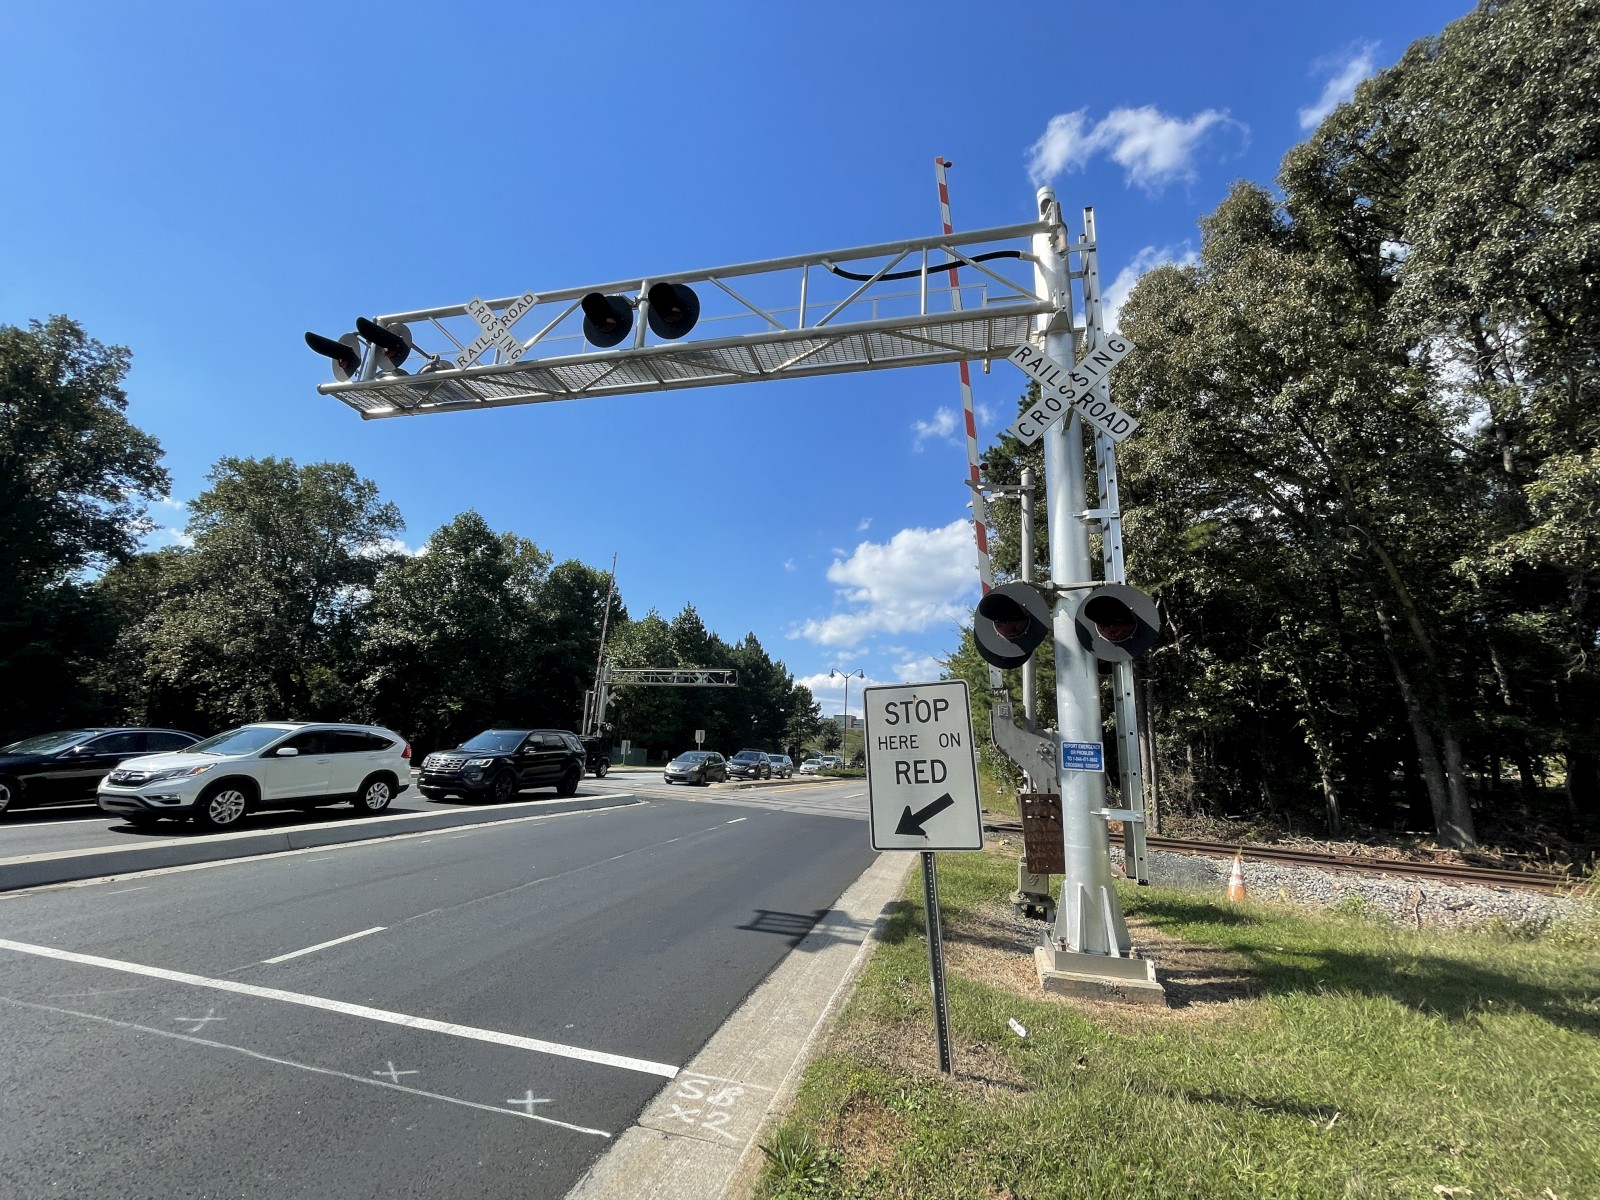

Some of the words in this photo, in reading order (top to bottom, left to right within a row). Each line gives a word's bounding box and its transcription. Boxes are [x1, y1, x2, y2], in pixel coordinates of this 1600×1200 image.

[457, 337, 490, 367] RAIL
[500, 294, 534, 326] ROAD
[469, 300, 522, 360] CROSSING
[1015, 346, 1060, 387] RAIL
[1076, 393, 1130, 434] ROAD
[1018, 339, 1126, 438] CROSSING
[878, 734, 920, 750] HERE
[938, 732, 961, 748] ON
[884, 698, 949, 726] STOP
[895, 758, 948, 785] RED
